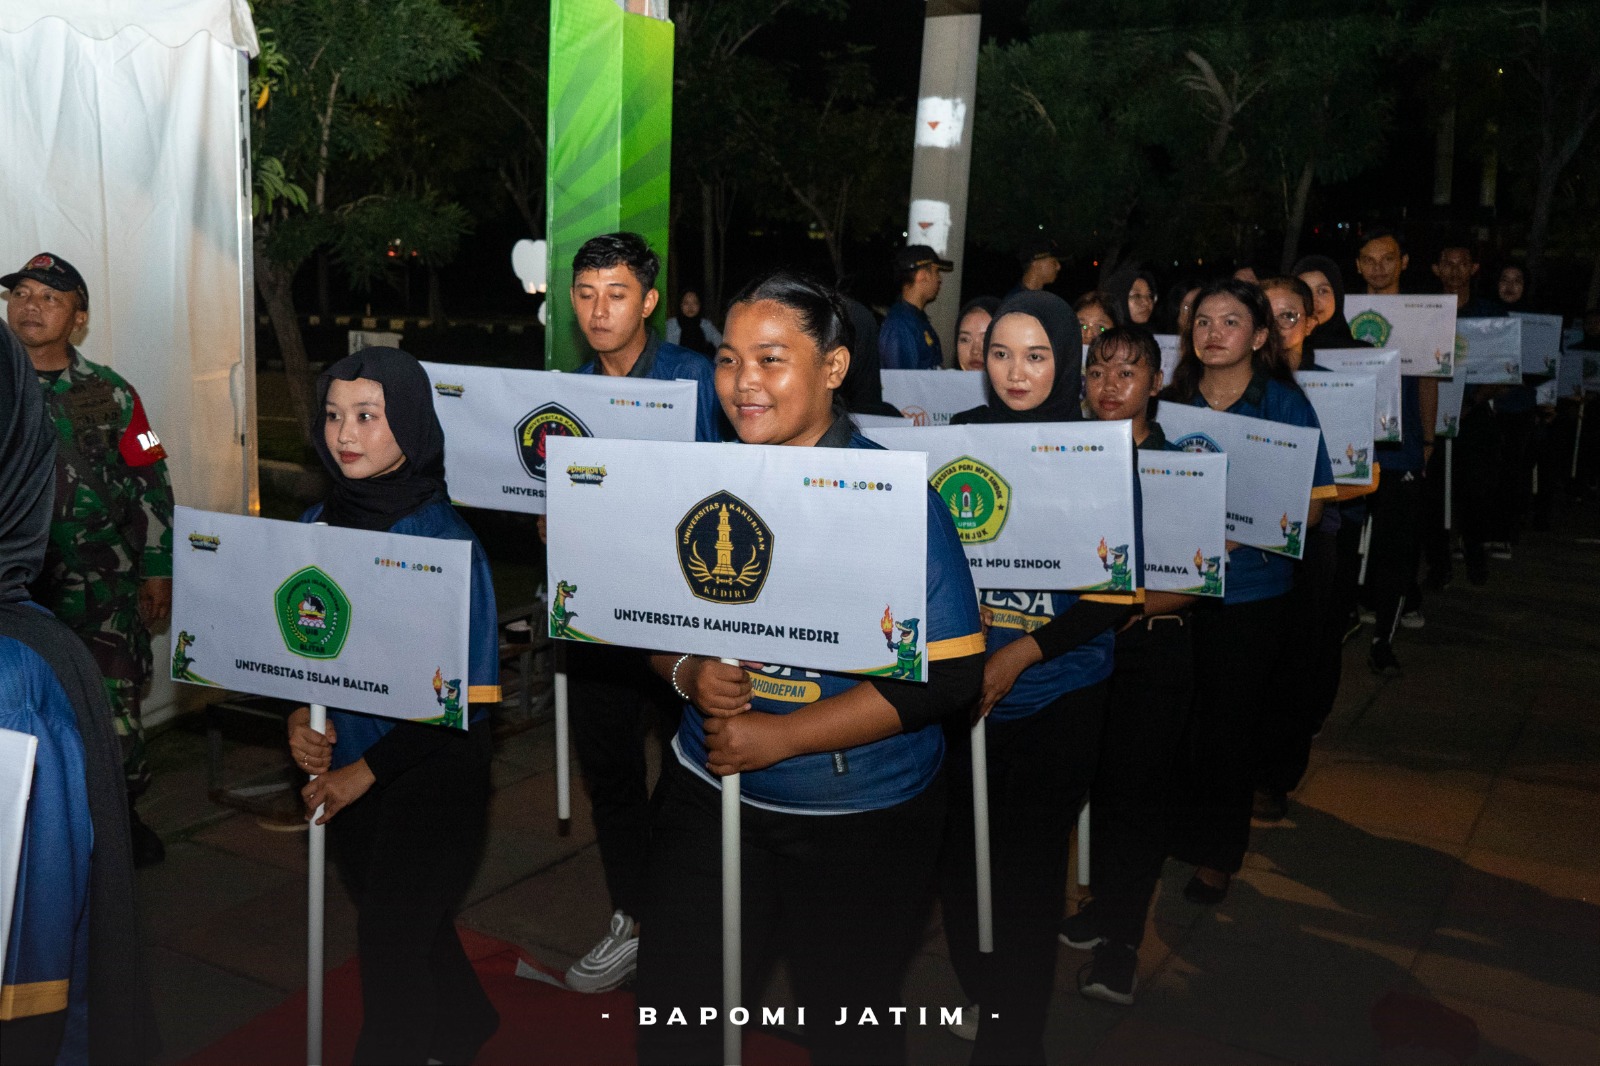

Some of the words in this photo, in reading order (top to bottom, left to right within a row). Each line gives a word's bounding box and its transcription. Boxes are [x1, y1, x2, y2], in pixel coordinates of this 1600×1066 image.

[137, 430, 160, 451] BA
[933, 466, 957, 489] VERSITAS
[975, 466, 990, 478] MPU
[683, 502, 720, 545] UNIVERSITAS
[729, 503, 766, 551] KAHURIPAN
[960, 528, 988, 540] ANJUK
[986, 558, 1011, 568] MPU
[1014, 559, 1061, 569] SINDOK
[1144, 563, 1189, 575] URABAYA
[703, 585, 747, 598] KEDIRI
[614, 608, 700, 629] UNIVERSITAS
[703, 617, 785, 638] KAHURIPAN
[789, 627, 839, 644] KEDIRI
[235, 659, 304, 680] UNIVERSITAS
[307, 671, 340, 686] ISLAM
[343, 678, 389, 695] BALITAR
[751, 677, 806, 698] AHDIDEPAN
